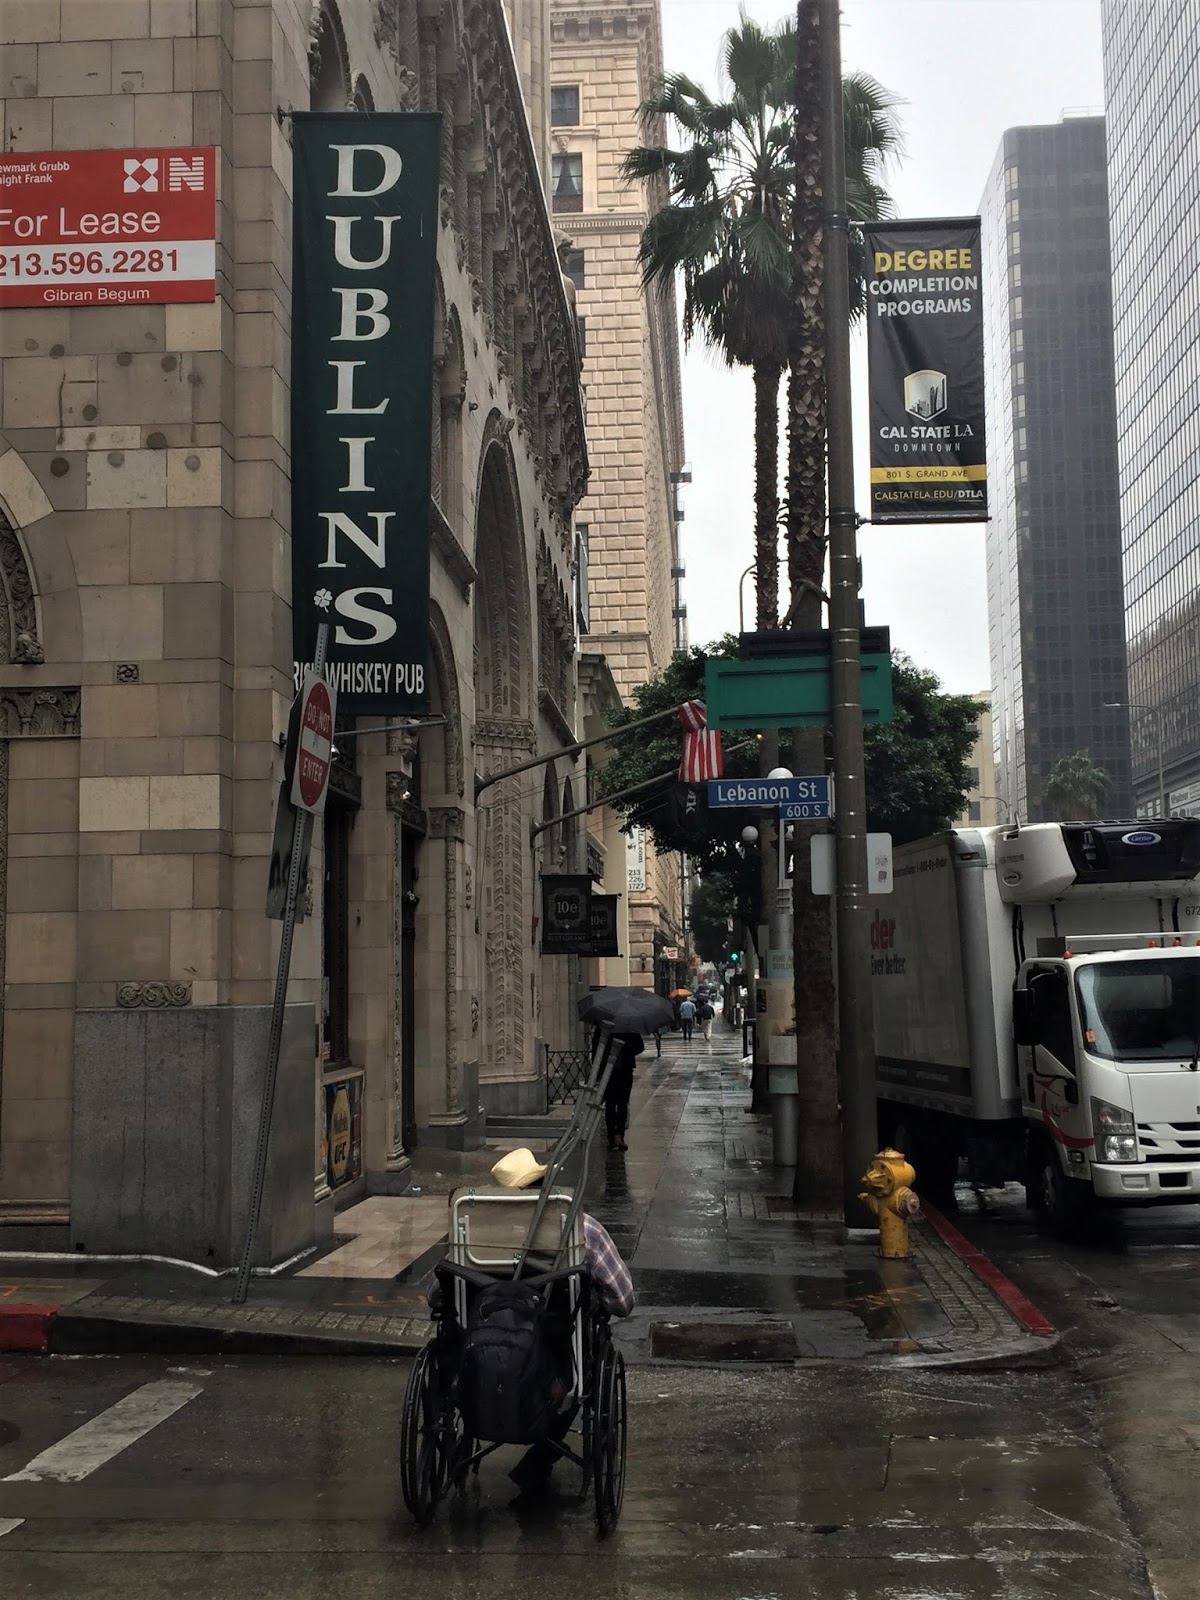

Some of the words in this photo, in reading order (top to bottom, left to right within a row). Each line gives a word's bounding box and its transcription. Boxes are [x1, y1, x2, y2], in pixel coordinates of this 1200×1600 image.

[39, 161, 70, 172] Grubb
[25, 173, 53, 184] Frank
[0, 208, 48, 238] For
[59, 207, 161, 236] Lease
[0, 249, 178, 277] 213.596.2281
[875, 248, 972, 273] DEGREE
[43, 289, 93, 302] Gibran
[98, 287, 150, 302] Begum
[869, 276, 978, 295] COMPLETION
[877, 298, 972, 317] PROGRAMS
[880, 426, 908, 439] CAL
[911, 425, 951, 439] STATE
[954, 424, 974, 437] LA
[894, 442, 961, 453] DOWNTOWN
[886, 471, 902, 479] 801
[916, 470, 949, 478] GRAND
[951, 469, 971, 478] AVE.
[874, 489, 984, 500] CALSTATELA.EDU/DTLA
[325, 661, 392, 694] WHISKEY
[395, 663, 425, 695] PUB
[307, 702, 317, 725] DO
[319, 710, 331, 733] NOT
[302, 757, 323, 785] ENTER
[718, 783, 790, 802] Lebanon
[798, 781, 817, 799] St
[786, 805, 809, 817] 600
[814, 804, 821, 816] S
